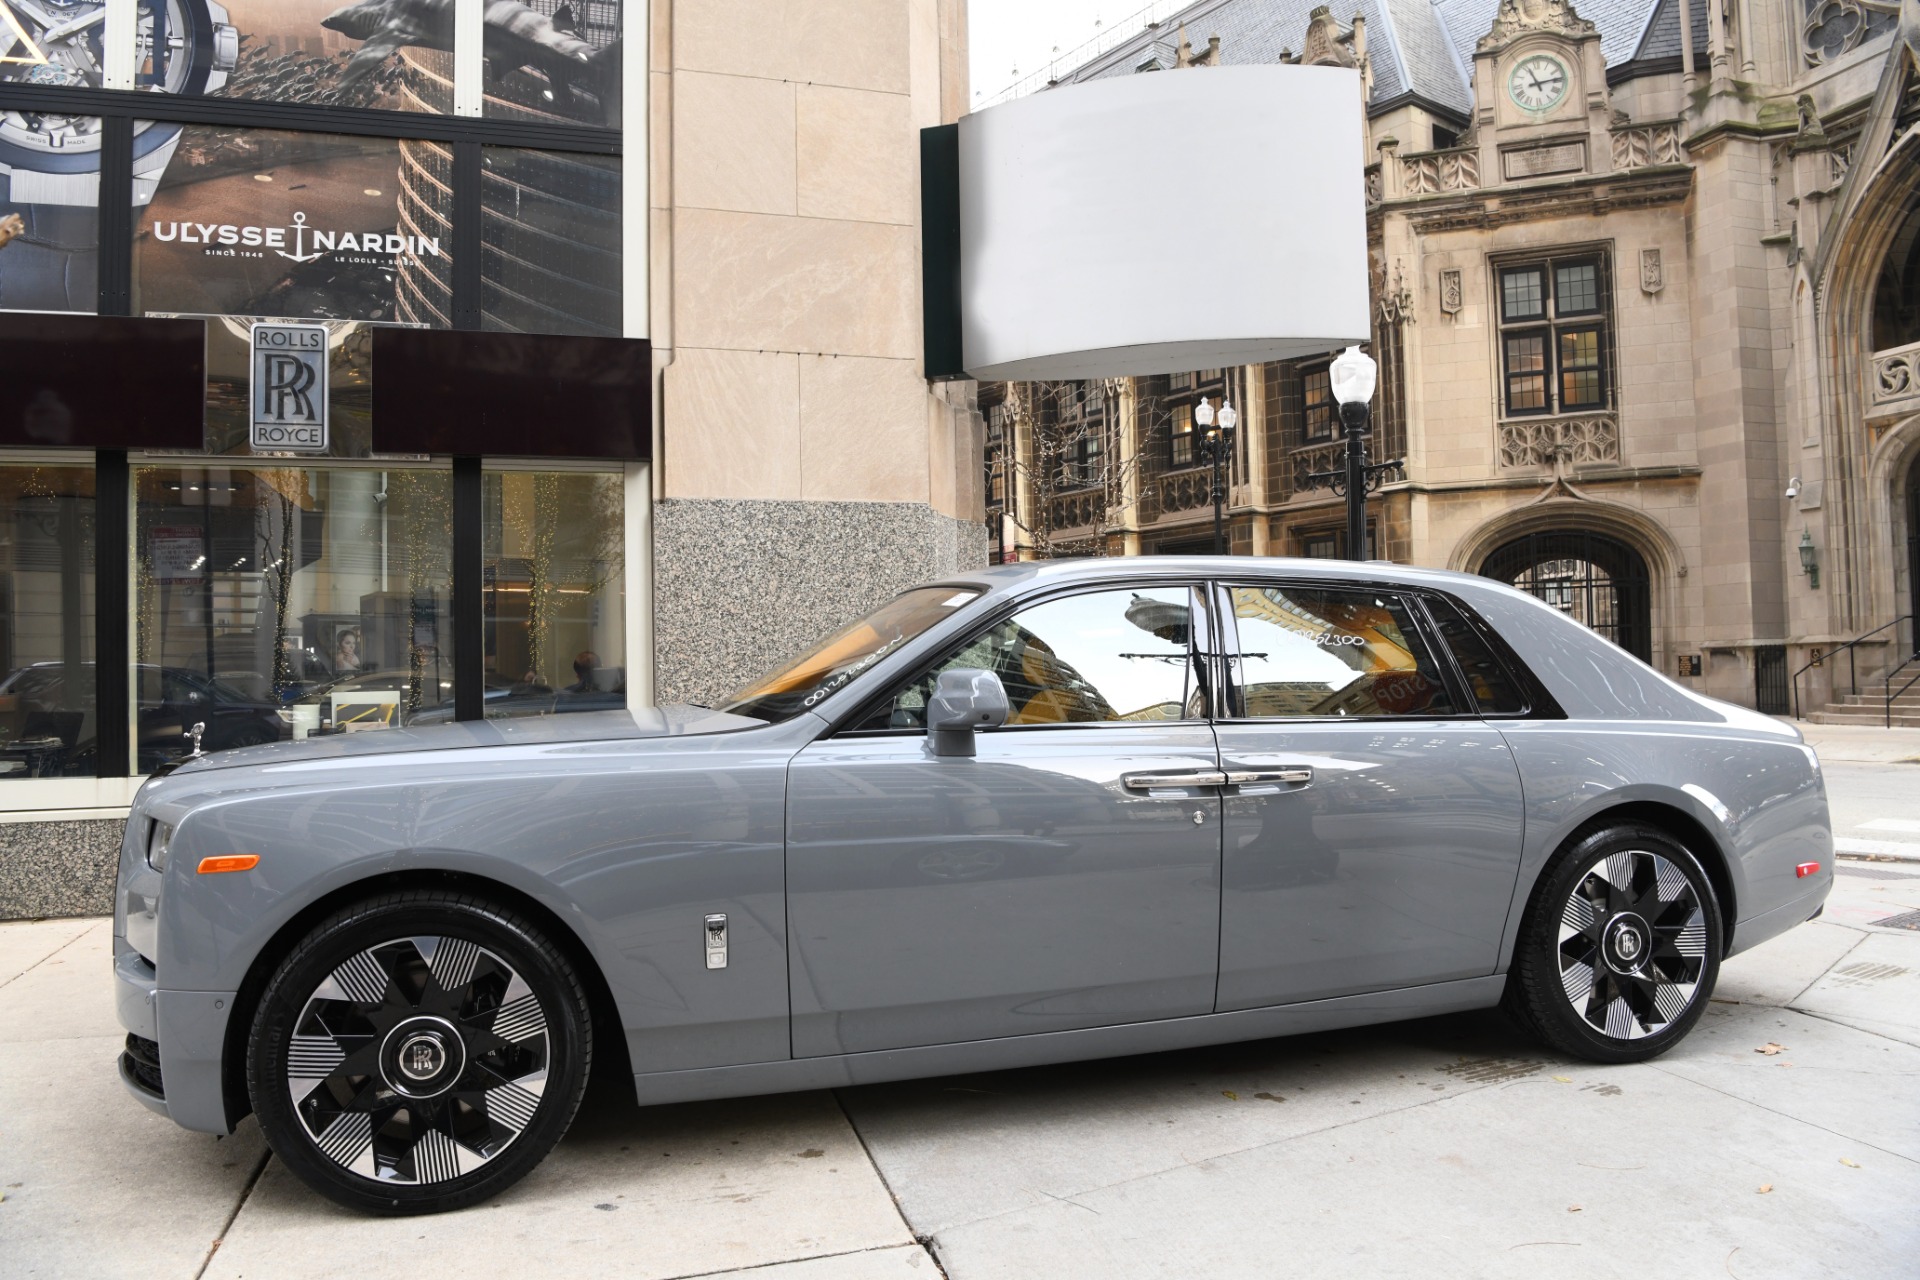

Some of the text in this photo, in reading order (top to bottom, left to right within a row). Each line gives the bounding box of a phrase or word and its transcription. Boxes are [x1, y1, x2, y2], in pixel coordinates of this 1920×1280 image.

[154, 221, 439, 256] ULYSSE NARDIN
[205, 249, 236, 257] SINCE
[349, 256, 377, 264] LOCLE
[258, 331, 319, 347] ROLLS
[258, 427, 319, 443] ROYCE
